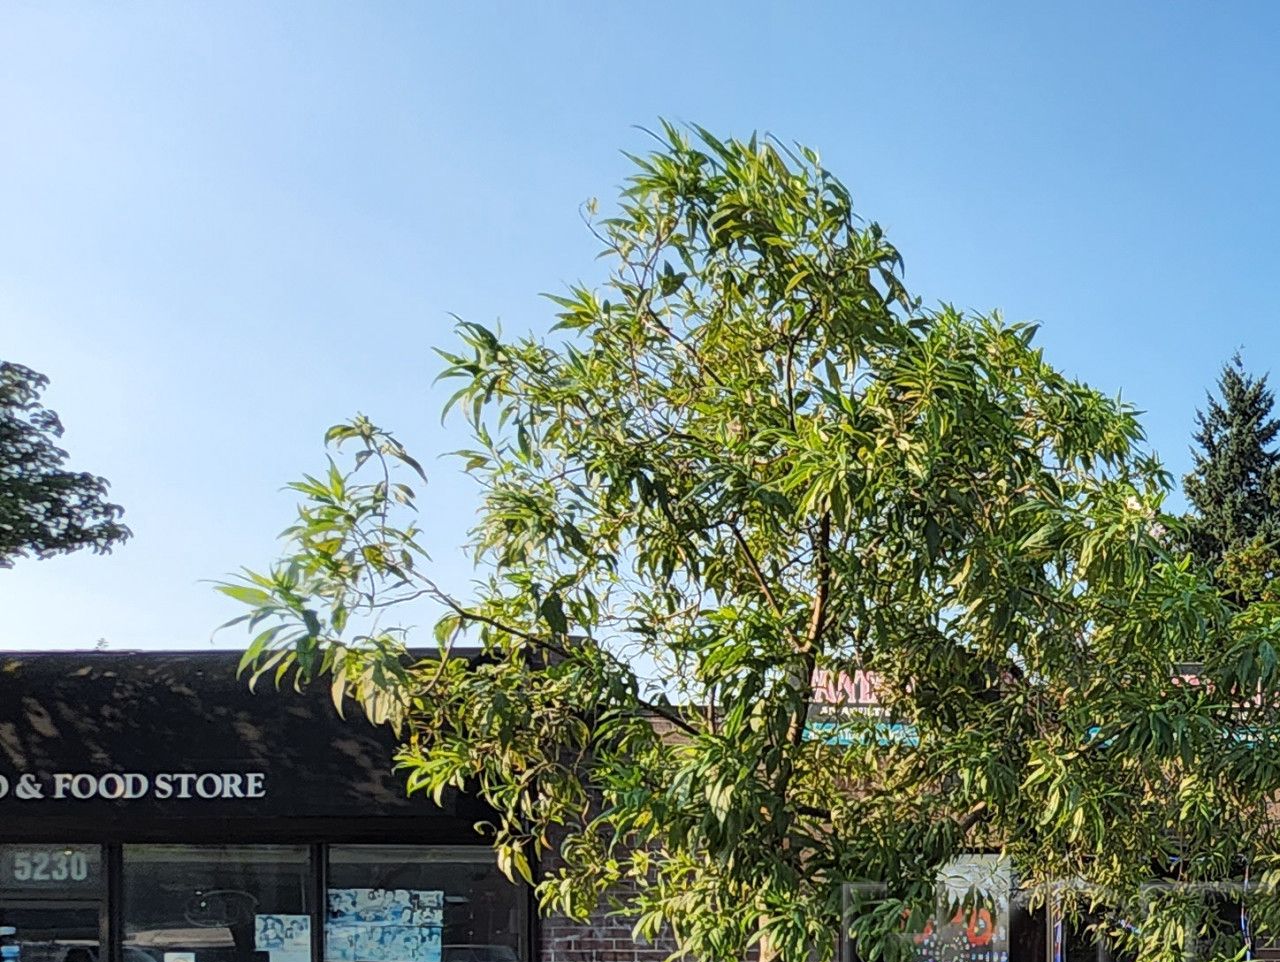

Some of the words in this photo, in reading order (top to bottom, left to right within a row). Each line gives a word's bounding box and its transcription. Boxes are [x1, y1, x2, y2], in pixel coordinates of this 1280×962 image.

[15, 773, 44, 799] &
[53, 773, 149, 799] FOOD
[155, 773, 266, 799] STORE
[14, 852, 88, 881] 5230
